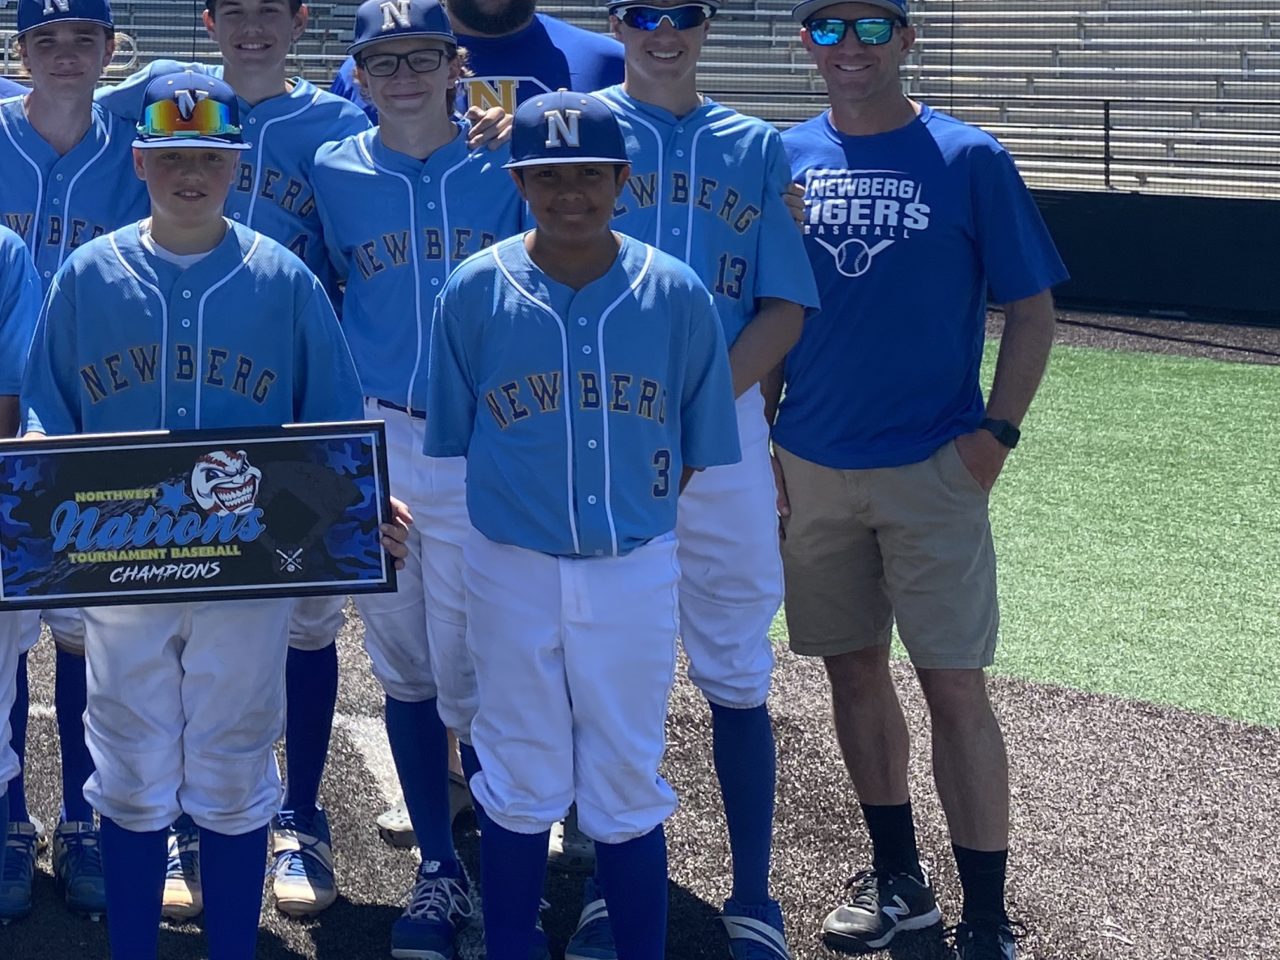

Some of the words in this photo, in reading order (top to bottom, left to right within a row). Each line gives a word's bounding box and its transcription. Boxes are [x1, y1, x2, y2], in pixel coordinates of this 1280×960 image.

[380, 0, 411, 32] N
[467, 80, 519, 114] N
[543, 109, 582, 148] N
[612, 171, 760, 235] WBERG
[811, 177, 915, 199] NEWBERG
[804, 225, 910, 239] BASEBALL
[714, 252, 748, 301] 13
[79, 344, 278, 408] NEWBERG
[651, 448, 672, 498] 3
[74, 488, 159, 503] NORTHWEST
[50, 500, 267, 553] Nations
[68, 548, 167, 564] TOURNAMENT
[171, 544, 242, 559] BASEBALL
[109, 560, 221, 583] CHAMPIONS
